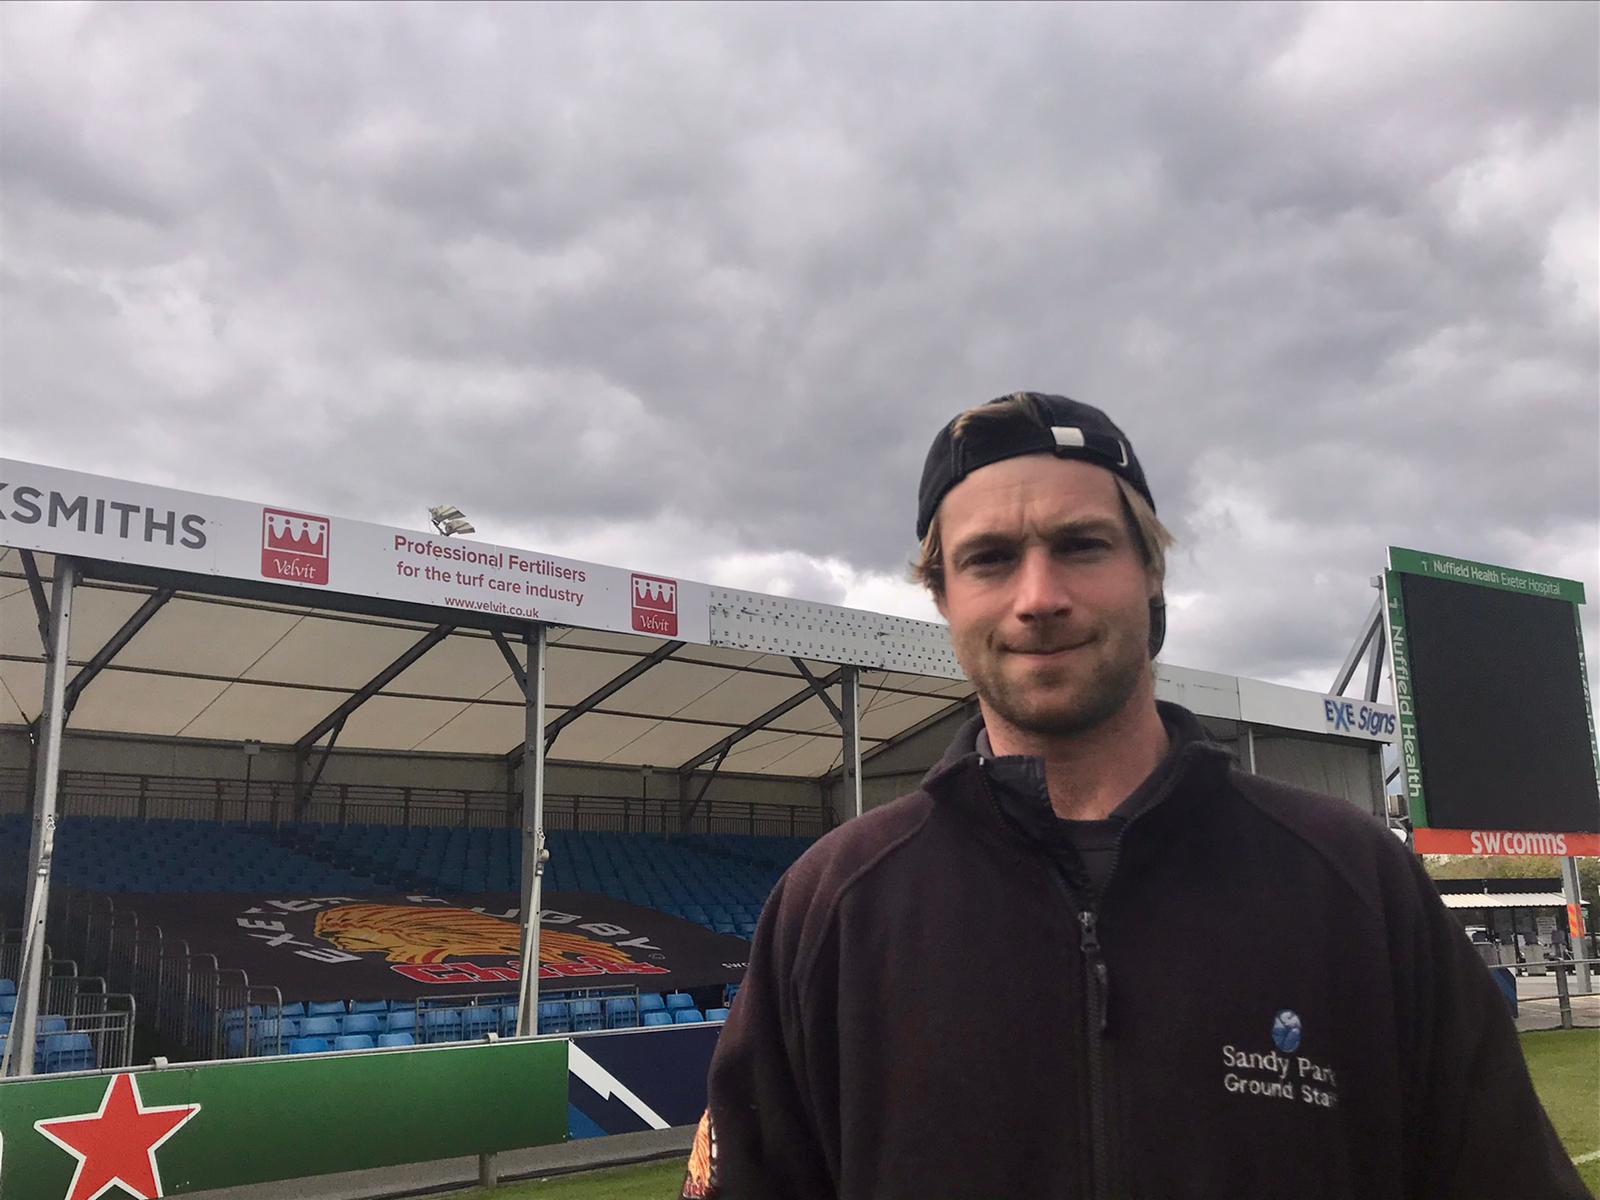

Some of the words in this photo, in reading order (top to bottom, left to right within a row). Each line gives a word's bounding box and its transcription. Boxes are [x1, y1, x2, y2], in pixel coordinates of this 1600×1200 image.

[273, 558, 317, 580] Velvit
[394, 534, 504, 569] Professional
[508, 554, 587, 583] Fertilisers
[396, 561, 420, 579] for
[424, 565, 452, 584] the
[456, 570, 484, 590] turf
[488, 578, 522, 595] care
[525, 581, 584, 607] industry
[1433, 559, 1470, 578] Nuffield
[1470, 566, 1500, 583] Health
[1500, 572, 1527, 590] Exeter
[1528, 579, 1561, 596] Hospital
[444, 594, 540, 619] www.velvit.co.uk
[639, 613, 669, 632] Velvit
[1391, 625, 1414, 716] Nuffield
[1324, 699, 1356, 732] EXE
[1358, 705, 1397, 737] Signs
[1402, 723, 1422, 797] Health
[1222, 1045, 1290, 1080] Sandy
[1224, 1073, 1294, 1100] Ground
